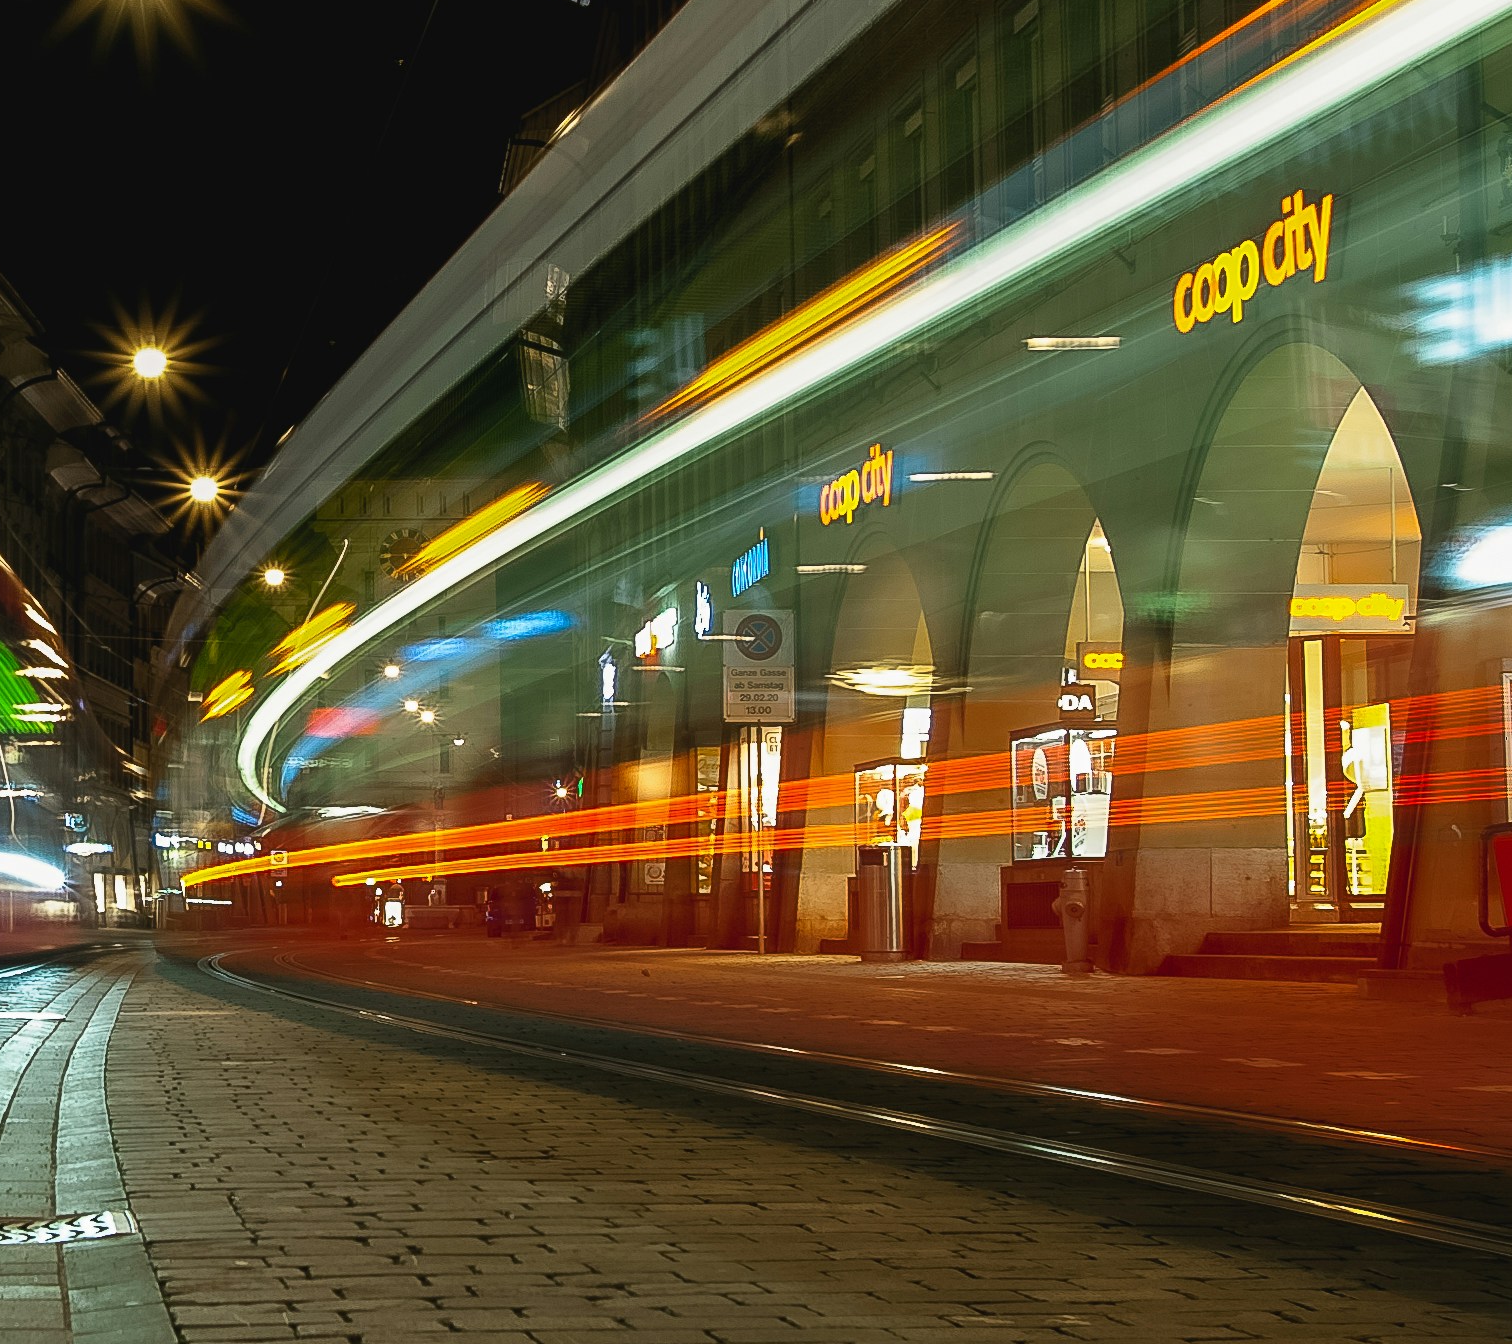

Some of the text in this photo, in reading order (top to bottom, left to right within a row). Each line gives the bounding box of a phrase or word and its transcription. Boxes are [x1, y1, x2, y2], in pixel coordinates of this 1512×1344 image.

[1174, 189, 1334, 334] coop city
[820, 443, 894, 525] coop city
[731, 669, 787, 677] Ganze Gasse
[734, 681, 784, 690] ab Samstag
[739, 694, 779, 702] 29.02.20
[746, 706, 772, 714] 13.00
